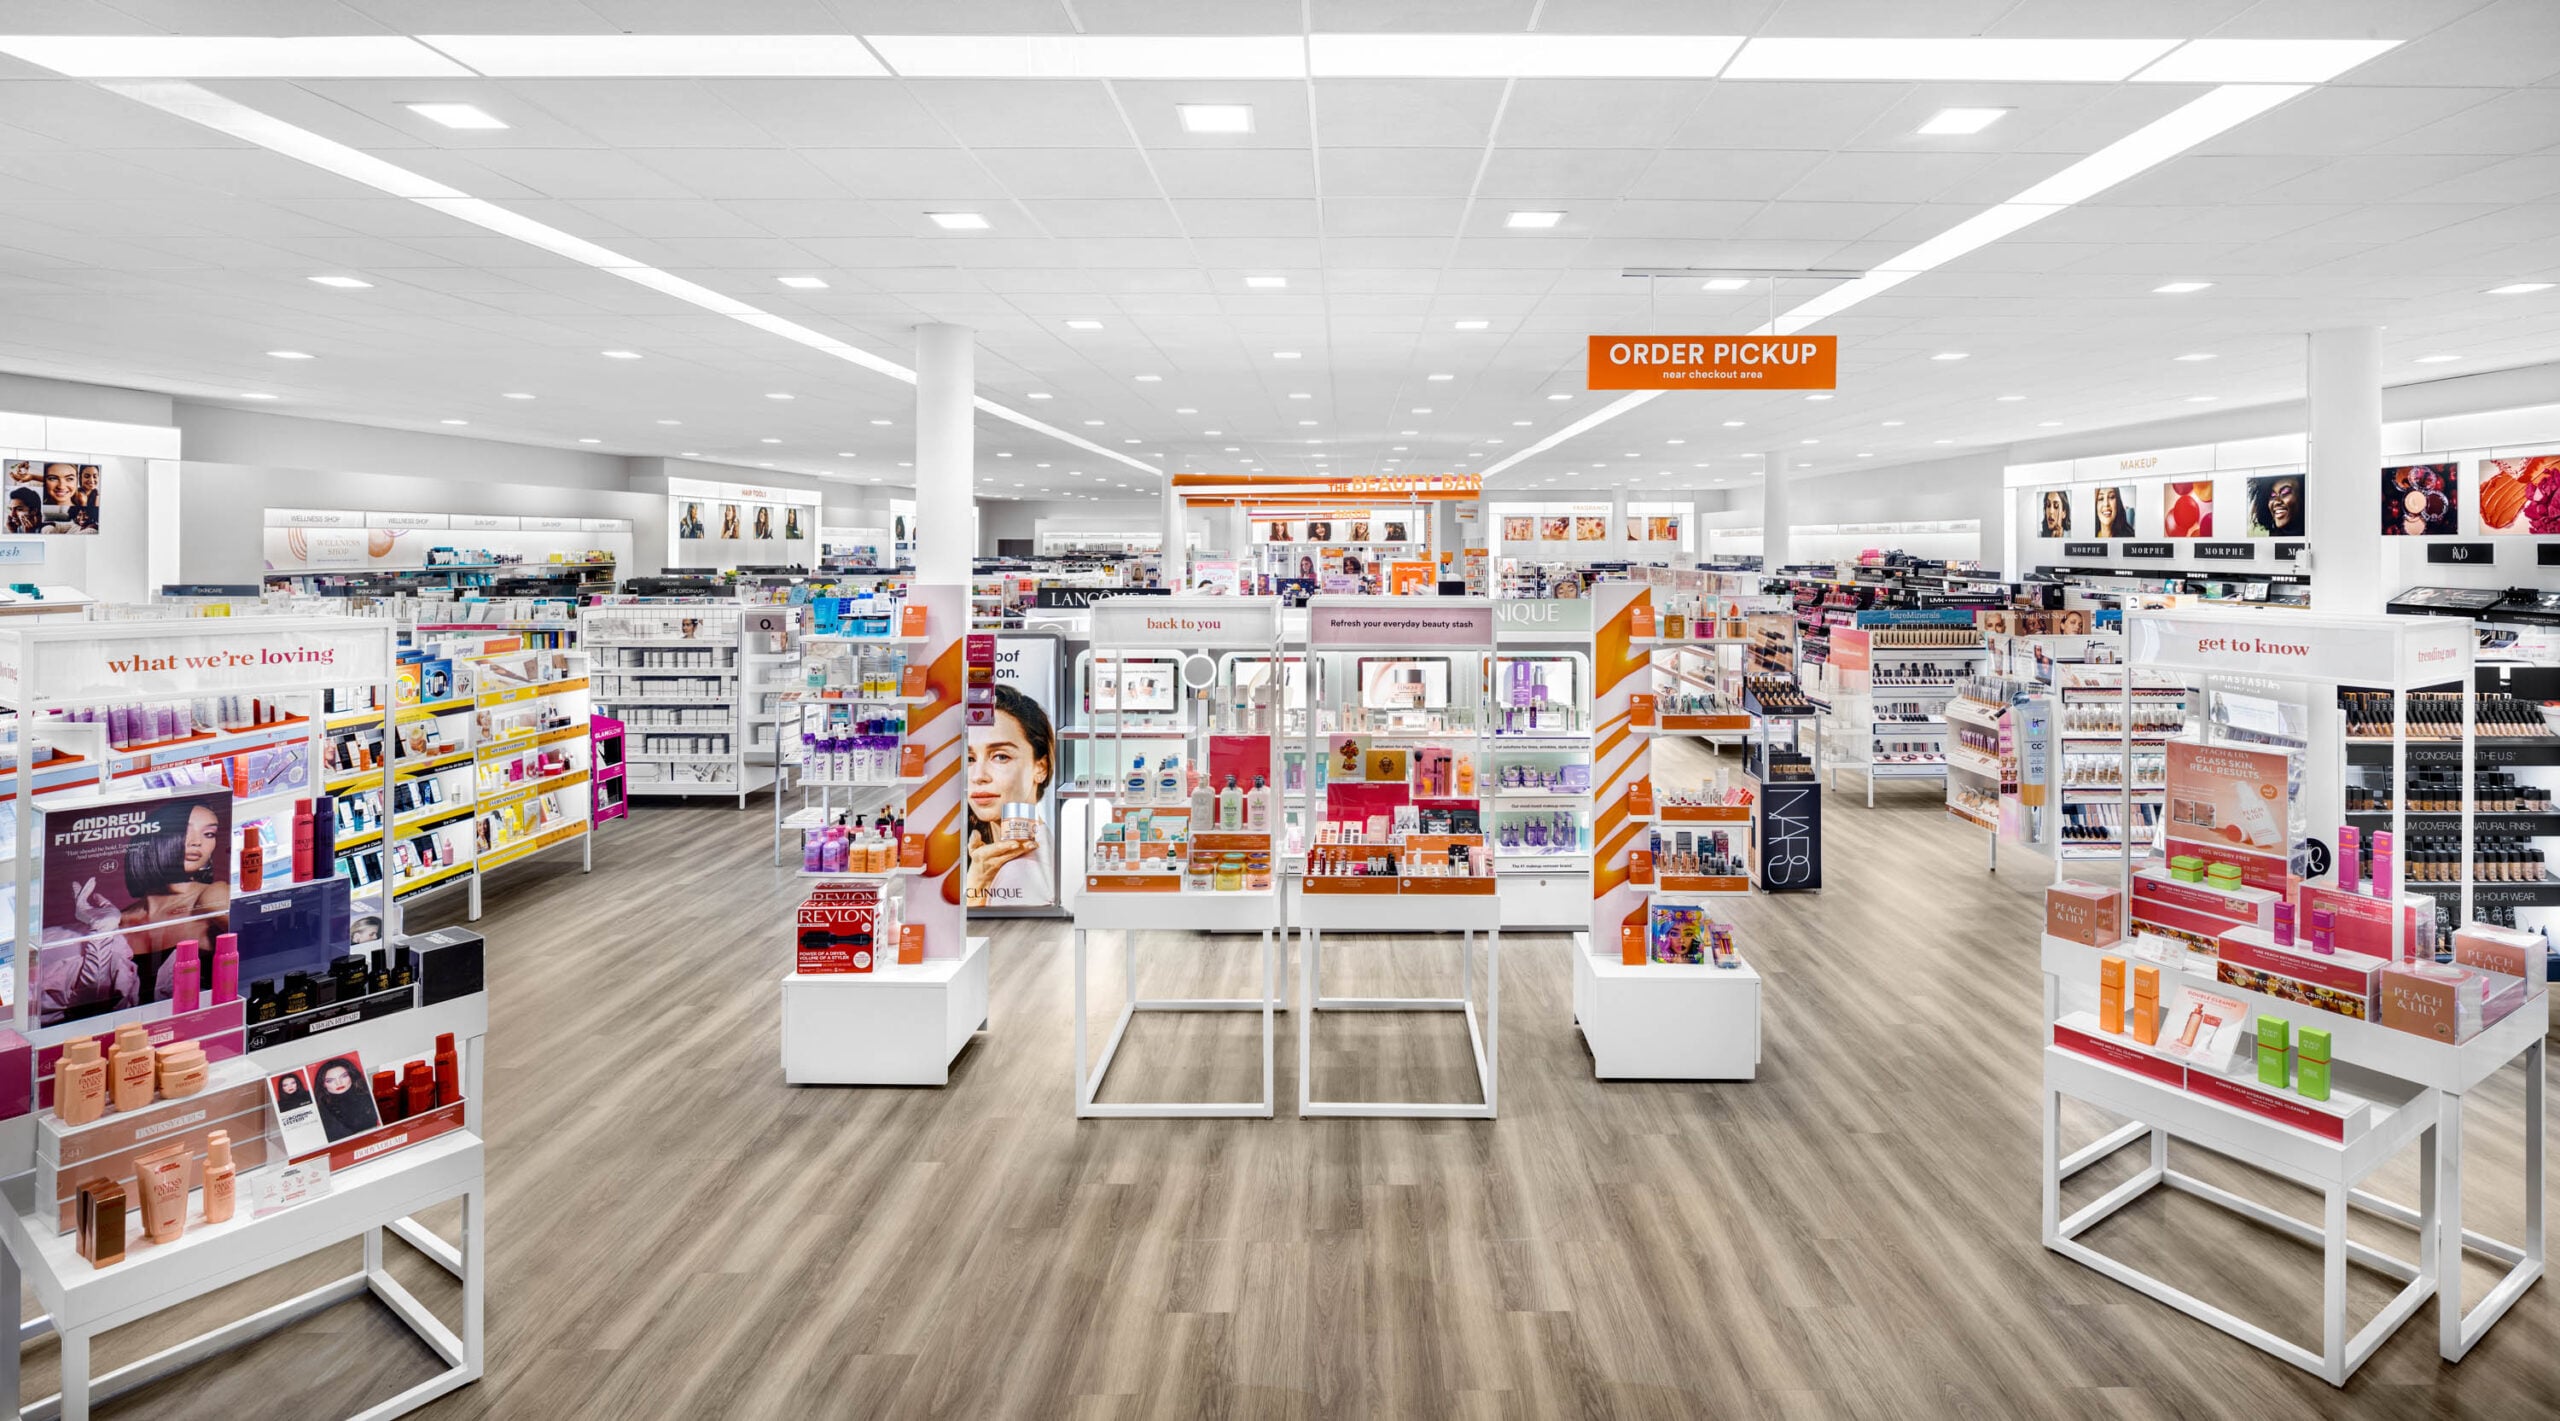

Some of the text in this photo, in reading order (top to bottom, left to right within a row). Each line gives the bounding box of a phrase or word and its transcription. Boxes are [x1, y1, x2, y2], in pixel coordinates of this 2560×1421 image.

[1609, 343, 1817, 365] ORDER PICKUP
[1663, 370, 1763, 379] near checkout area
[2120, 457, 2158, 470] MAKEUP
[1328, 472, 1483, 492] THE BEAUTY BAR
[290, 515, 323, 523] WELLNESS
[2204, 547, 2245, 555] MORPHE
[1889, 610, 1941, 619] bareMinerals
[2019, 612, 2034, 620] Your
[2035, 612, 2050, 620] Best
[1147, 617, 1221, 631] back to you
[1330, 619, 1473, 629] Refresh your everyday beauty stash
[2198, 638, 2310, 656] get to know
[108, 646, 335, 673] what we're loving
[2418, 647, 2457, 662] trending now
[2208, 674, 2281, 690] ANASTASIA
[594, 727, 622, 739] GLAMGLOW
[2195, 756, 2256, 770] GLASS SKIN.
[2415, 752, 2463, 760] CONCEALE
[2480, 752, 2495, 760] THE
[2190, 763, 2262, 779] REAL RESULTS.
[72, 811, 146, 831] ANDREW
[2510, 822, 2536, 831] FINISH.
[54, 821, 161, 846] FITZSIMONS
[1768, 788, 1811, 884] NARS
[2213, 850, 2234, 859] WORRY
[2235, 854, 2251, 862] FREE
[966, 888, 1023, 899] CLINIQUE
[2475, 892, 2536, 901] 6-HOUR WEAR.
[262, 900, 290, 912] STYLING
[2055, 902, 2087, 917] PEACH
[799, 909, 873, 923] REVLON
[2057, 912, 2084, 925] & LILY
[2467, 950, 2513, 968] PEACH
[2187, 990, 2238, 1008] DOUBLE CLEANSE
[2394, 987, 2443, 1007] PEACH
[2397, 999, 2440, 1017] & LILY
[310, 1013, 359, 1031] VIRGIN REPAIR
[125, 1062, 151, 1072] FANTASY
[79, 1074, 103, 1085] FANTASY
[137, 1120, 176, 1138] FANTASY
[376, 1135, 405, 1150] VOLUME
[154, 1178, 182, 1190] FANTASY
